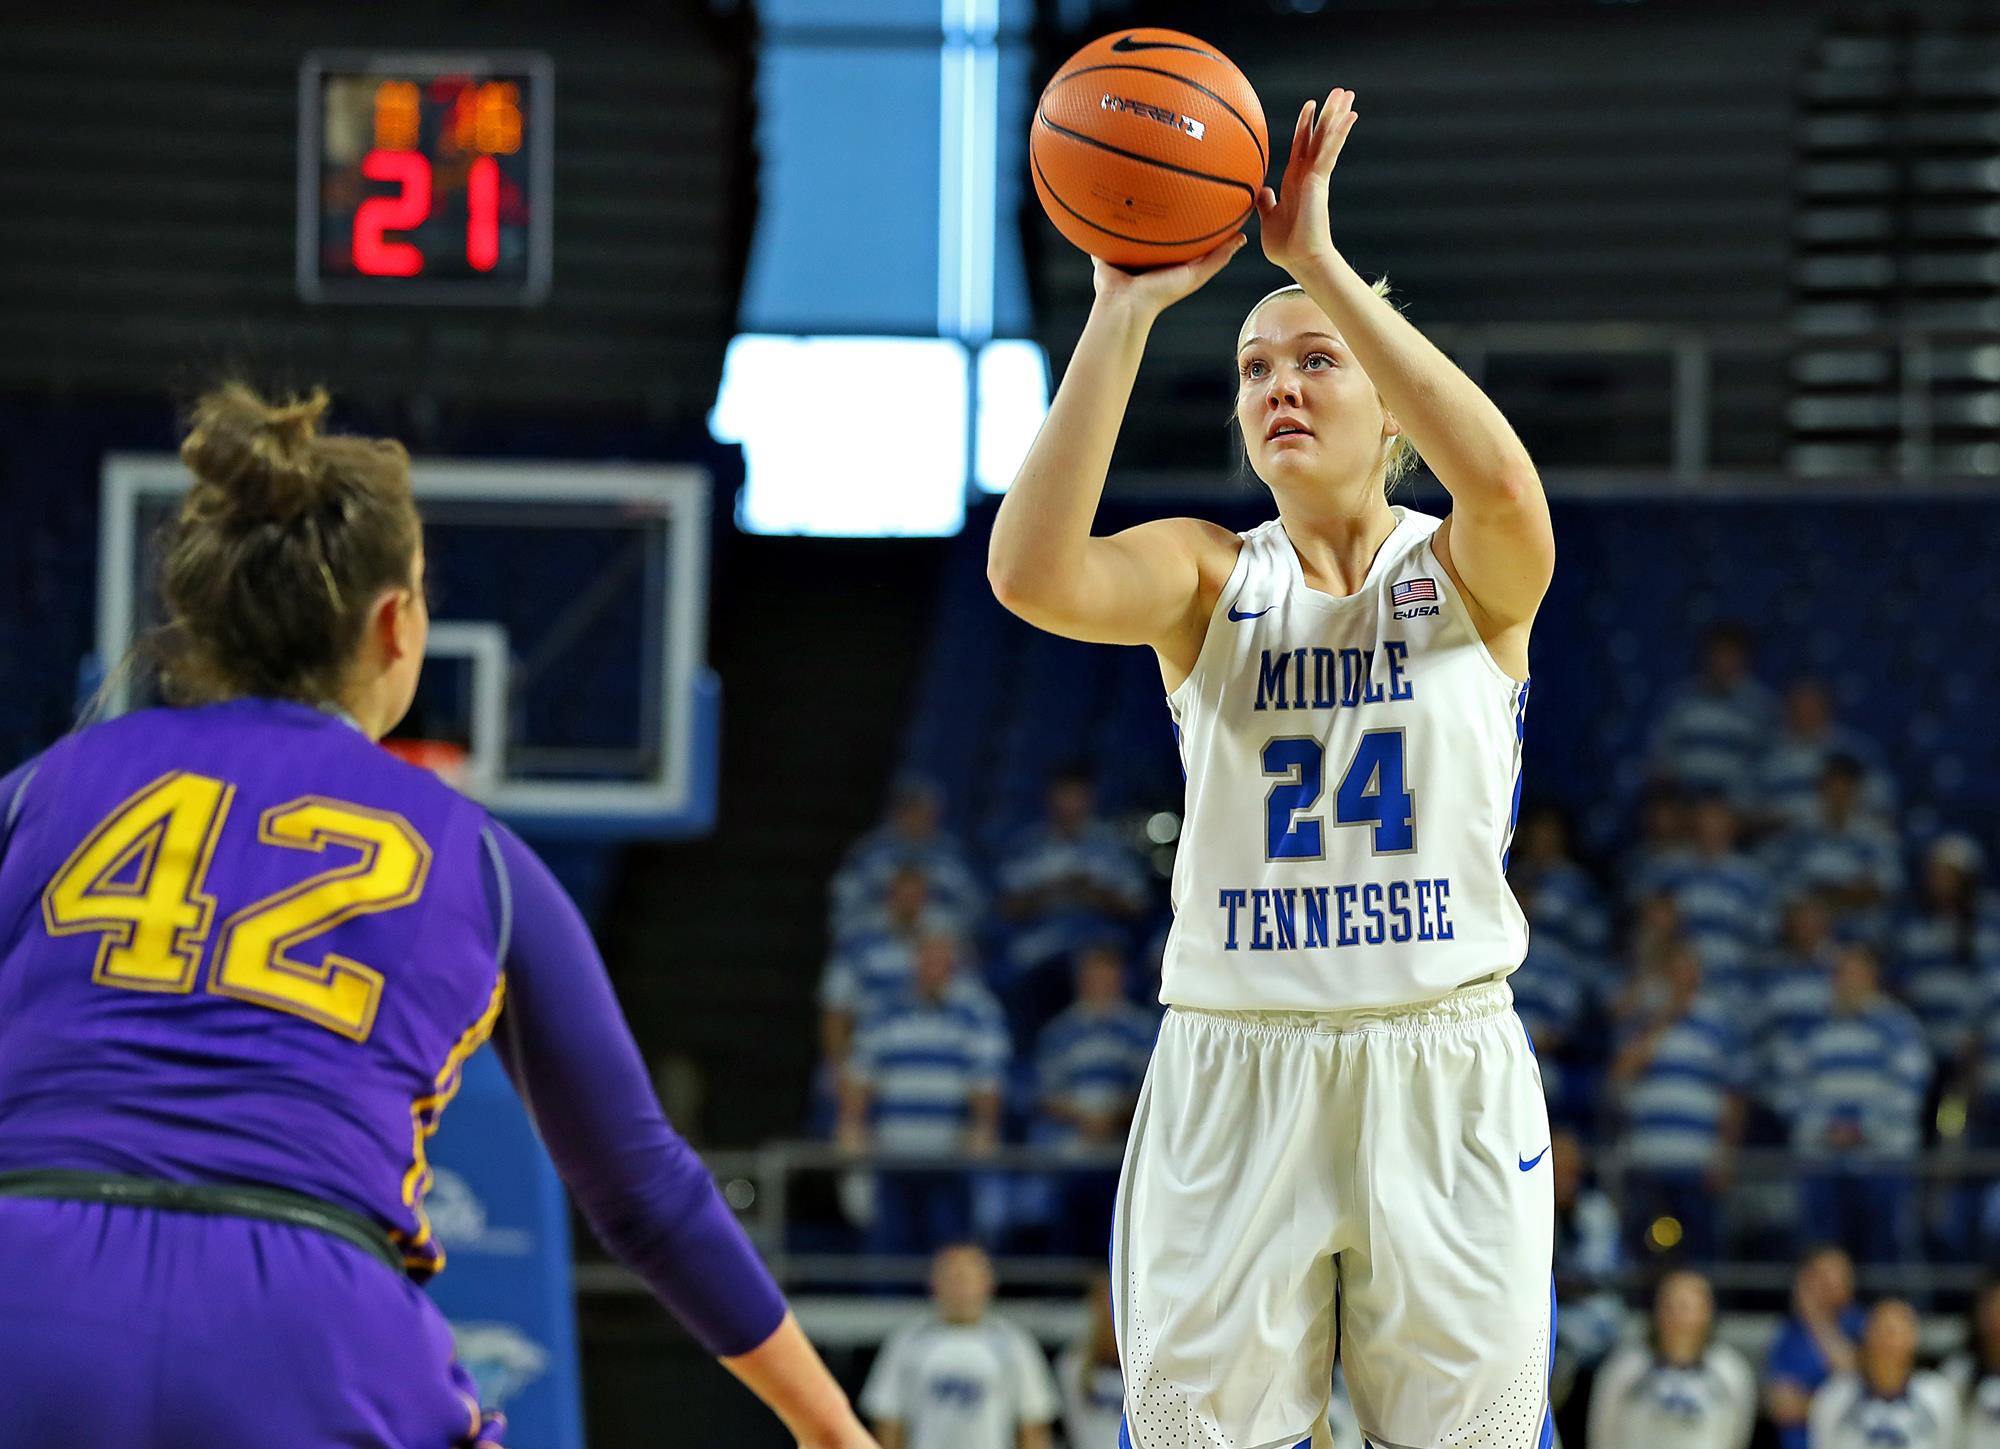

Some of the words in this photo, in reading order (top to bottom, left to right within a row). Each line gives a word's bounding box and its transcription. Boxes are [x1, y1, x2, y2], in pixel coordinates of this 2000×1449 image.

[352, 150, 499, 277] 21
[1254, 641, 1414, 712] MIDDLE
[1259, 726, 1418, 864] 24
[41, 769, 433, 1044] 42
[1219, 879, 1455, 952] TENNESSEE
